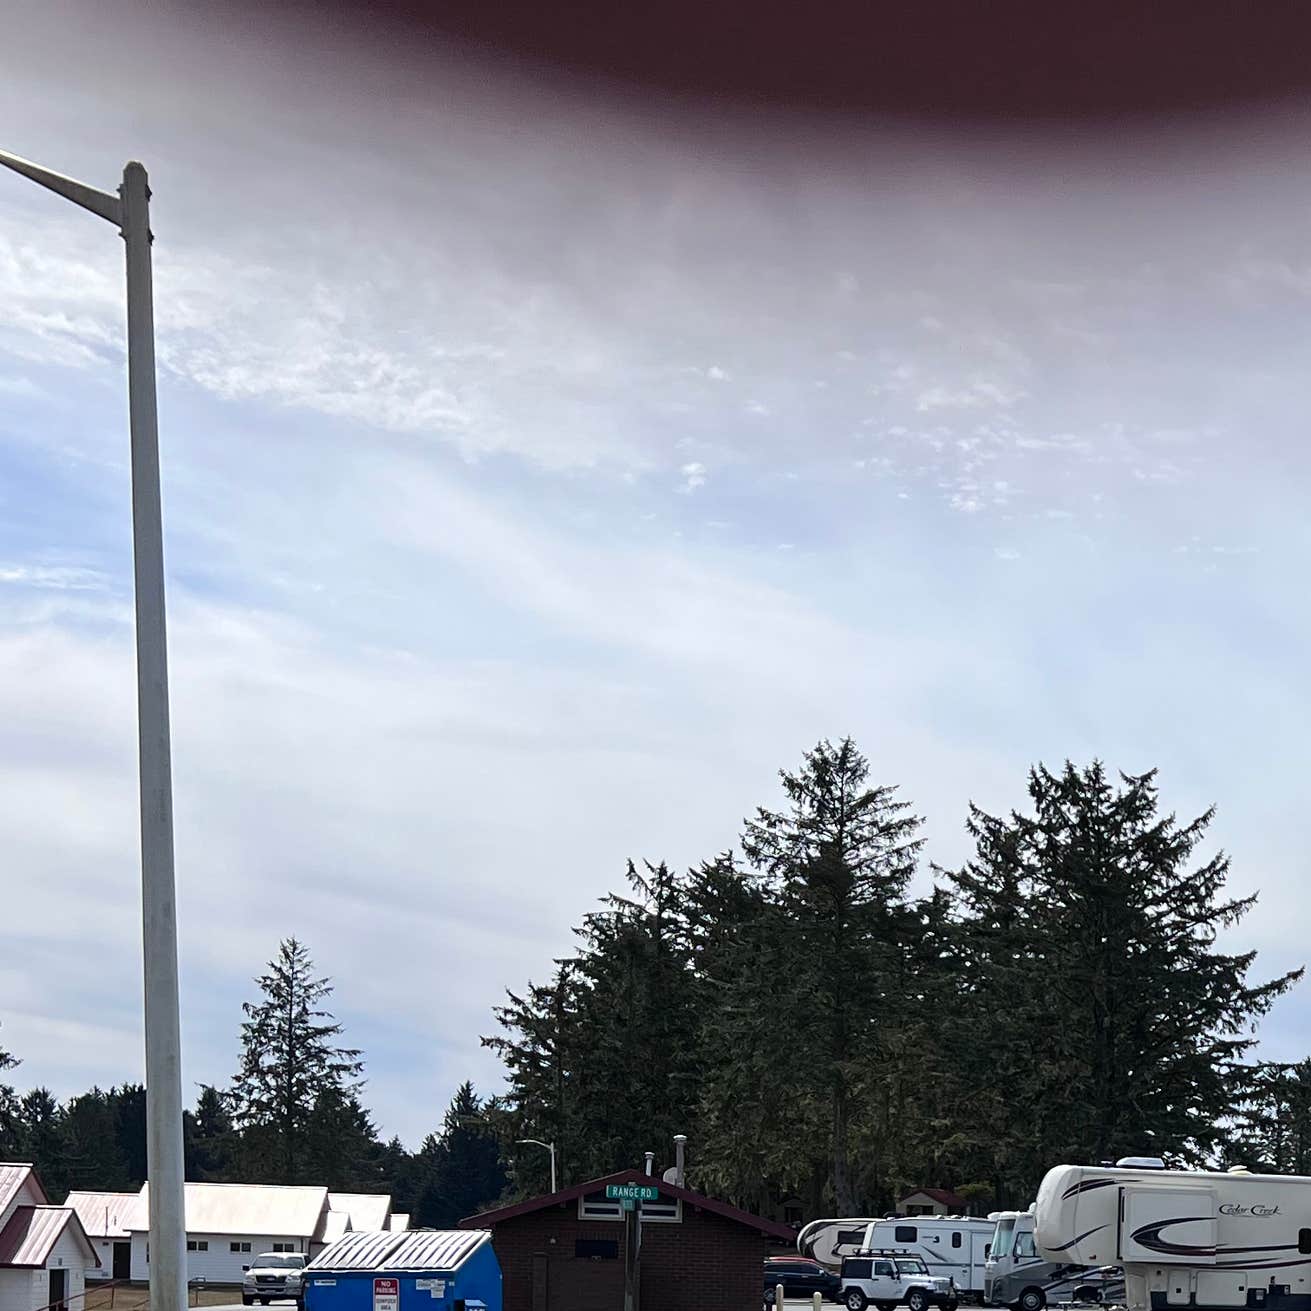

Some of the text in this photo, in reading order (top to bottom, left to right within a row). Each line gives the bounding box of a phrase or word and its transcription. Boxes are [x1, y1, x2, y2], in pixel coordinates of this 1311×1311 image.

[612, 1186, 652, 1198] RANGE RD
[1219, 1203, 1282, 1216] Cedar Creek
